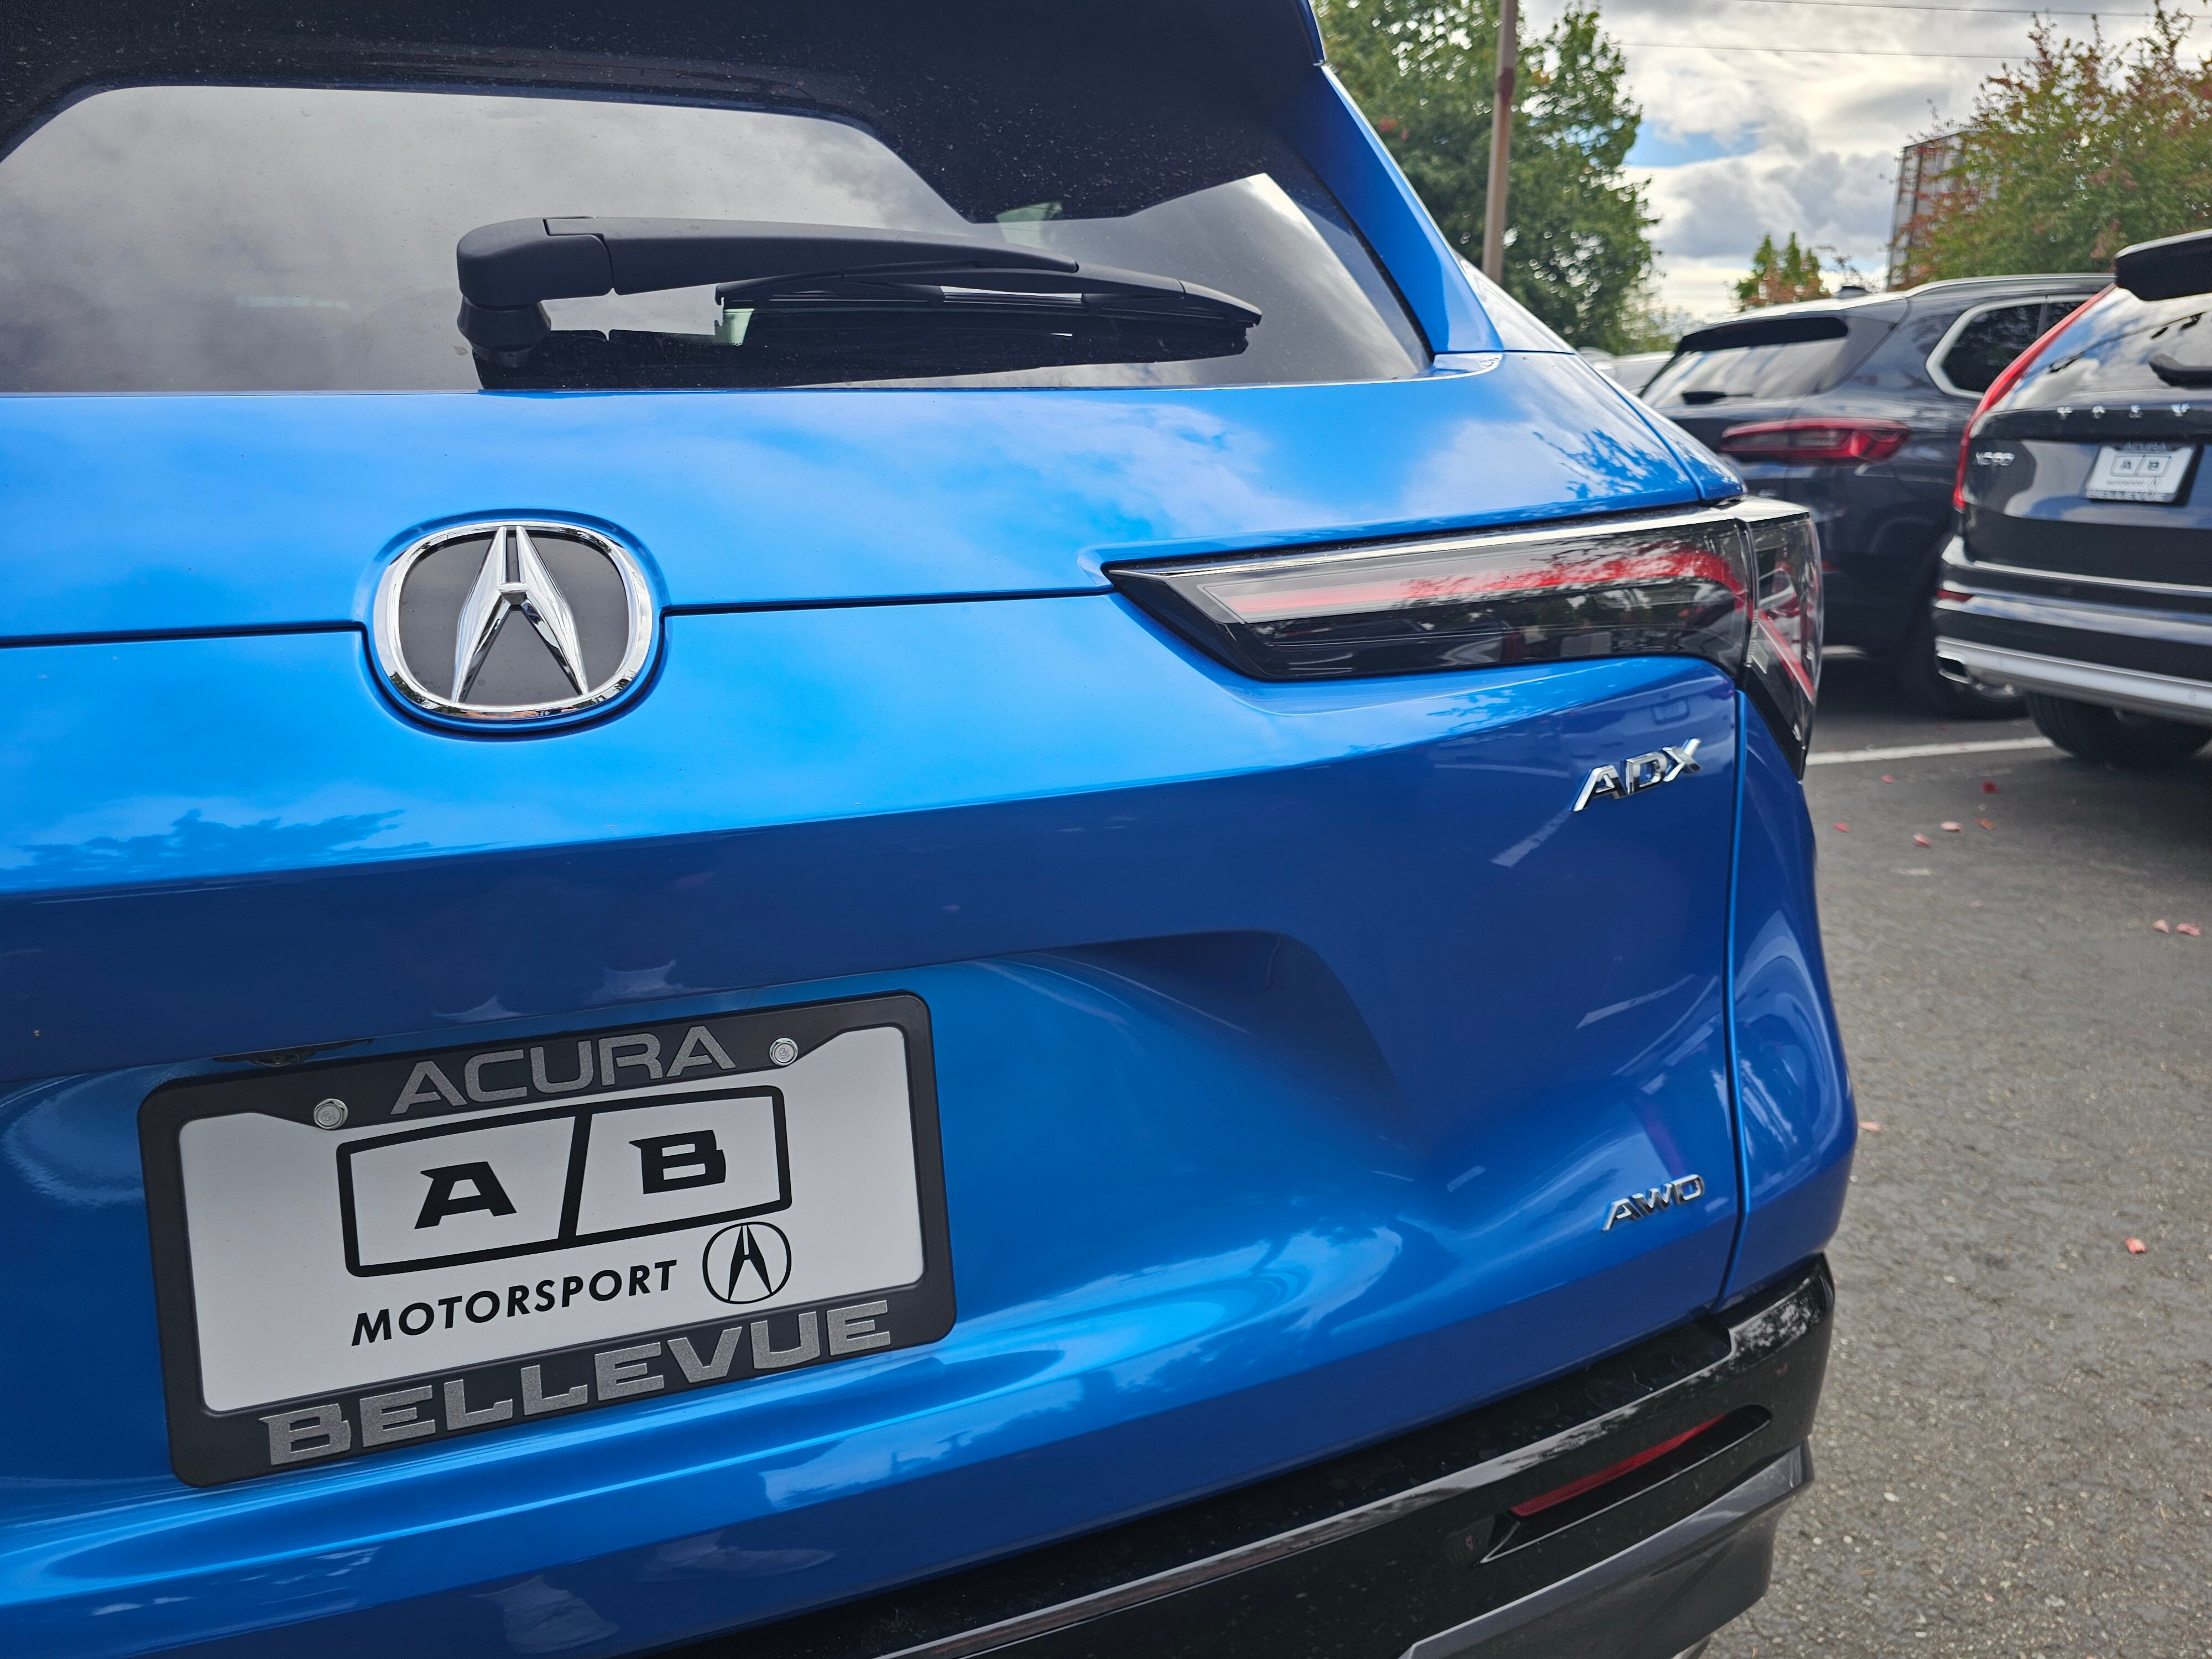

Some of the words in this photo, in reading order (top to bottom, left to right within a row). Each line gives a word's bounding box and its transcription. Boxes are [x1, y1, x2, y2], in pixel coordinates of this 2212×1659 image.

[1572, 738, 1702, 812] ADX
[389, 1025, 735, 1115] ACURA
[414, 1161, 517, 1229] A
[628, 1129, 727, 1194] B
[1601, 1173, 1705, 1232] AWD
[351, 1260, 677, 1346] MOTORSPORT
[259, 1300, 891, 1467] BELLEVUE
